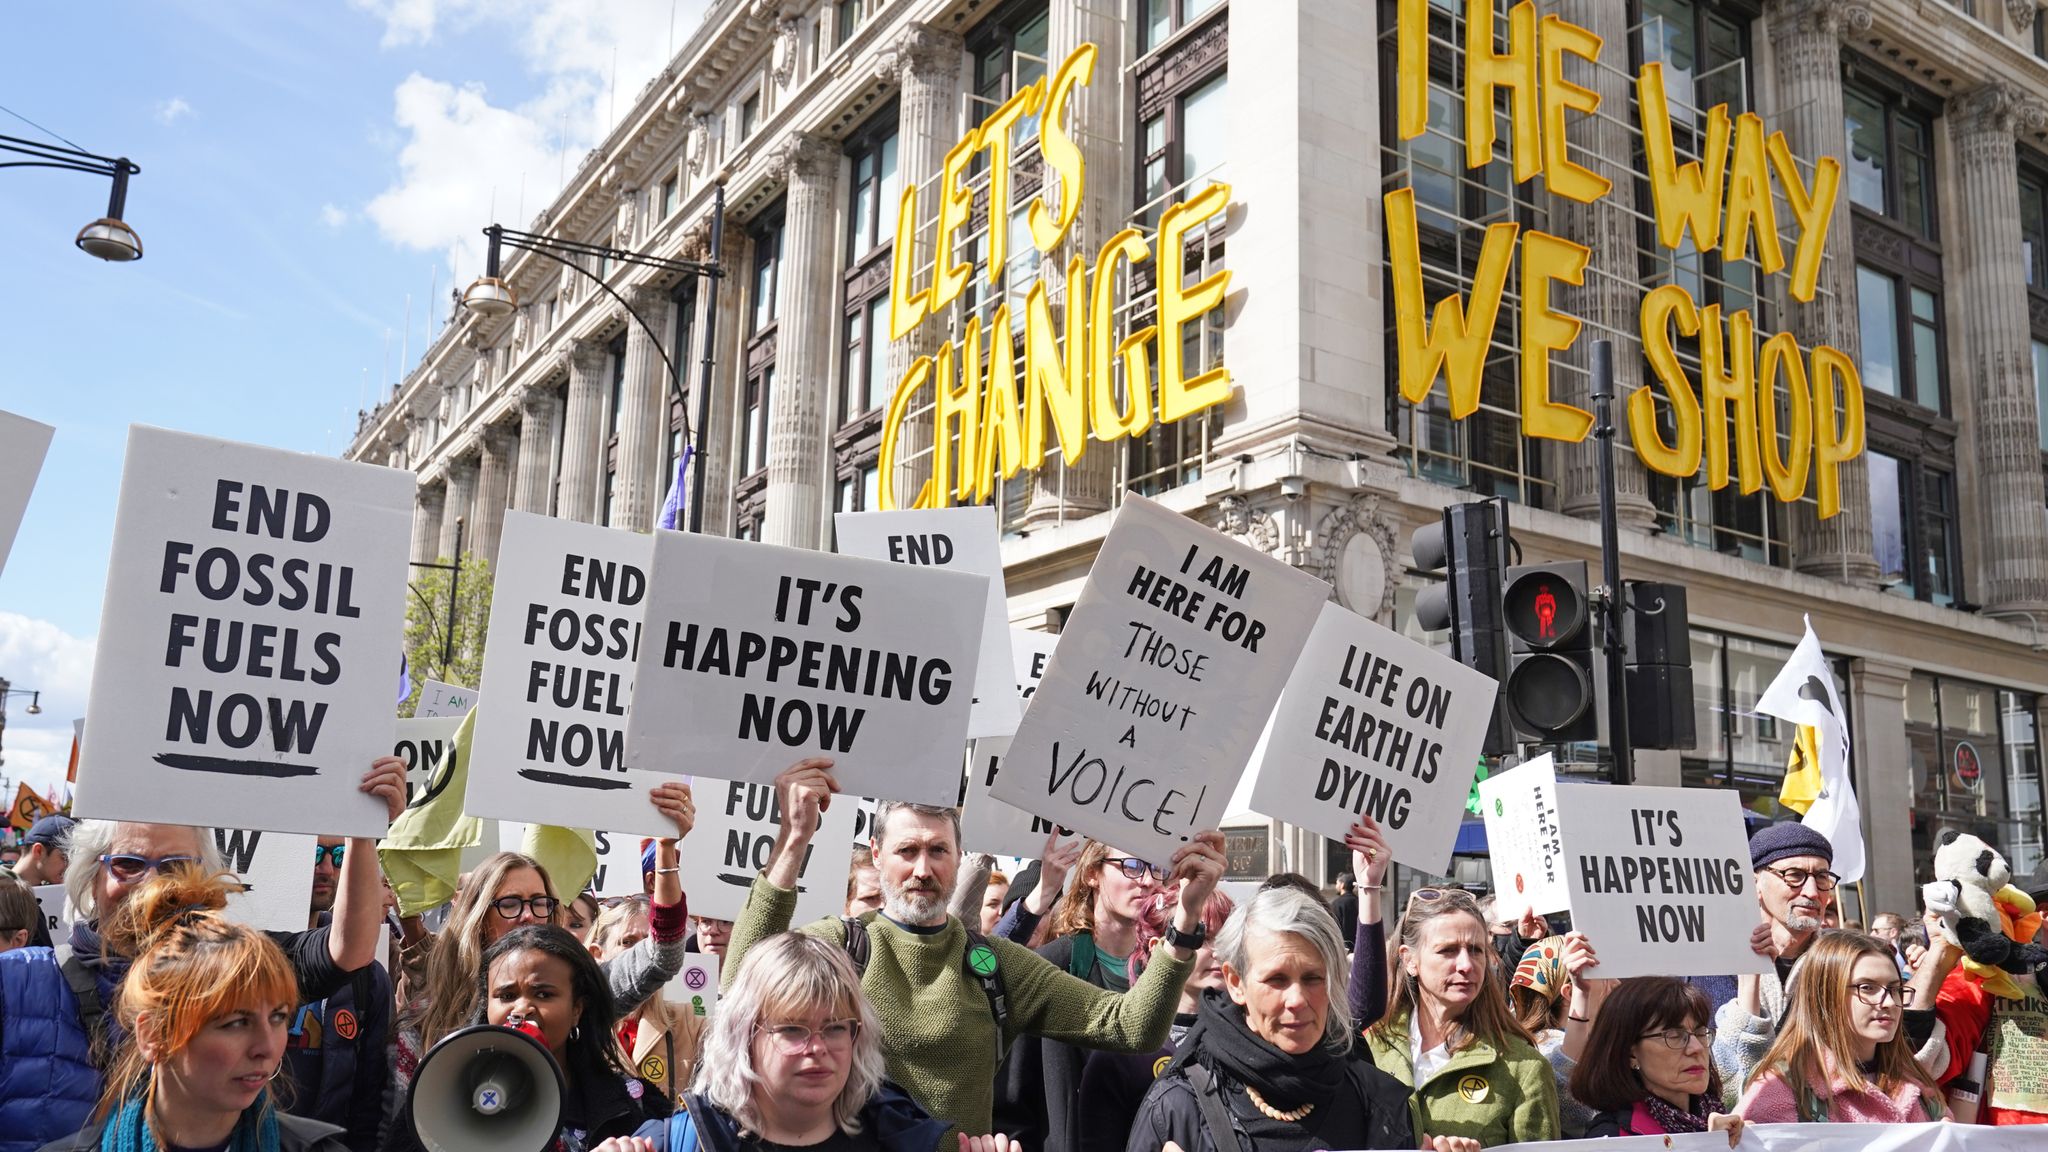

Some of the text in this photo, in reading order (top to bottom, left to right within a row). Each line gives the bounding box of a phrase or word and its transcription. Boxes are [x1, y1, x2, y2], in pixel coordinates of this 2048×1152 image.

[890, 42, 1098, 341] LET'S
[1636, 62, 1841, 302] WAY
[878, 183, 1233, 511] CHANGE
[1384, 187, 1864, 520] WE SHOP
[212, 478, 331, 543] END
[160, 540, 360, 618] FOSSIL
[561, 553, 646, 606] END
[889, 533, 954, 565] END
[1180, 544, 1251, 600] I AM
[524, 603, 643, 662] FOSSI
[774, 575, 864, 633] IT'S
[1126, 565, 1267, 654] HERE FOR
[165, 613, 341, 685] FUELS
[663, 620, 953, 706] HAPPENING
[1123, 621, 1210, 683] THOSE
[447, 695, 468, 710] AM
[526, 660, 635, 716] FUEL
[1086, 669, 1197, 733] WITHOUT
[1338, 645, 1453, 731] LIFE ON
[165, 687, 329, 755] NOW
[738, 693, 866, 754] NOW
[1119, 726, 1136, 748] A
[1314, 695, 1444, 785] EARTH IS
[1048, 741, 1207, 842] VOICE!
[1314, 758, 1412, 830] DYING
[1533, 785, 1555, 884] HERE FOR
[1549, 823, 1561, 856] AM
[1631, 808, 1683, 847] IT'S
[1579, 855, 1744, 896] HAPPENING
[1636, 904, 1705, 943] NOW
[1994, 995, 2048, 1016] TRIKE
